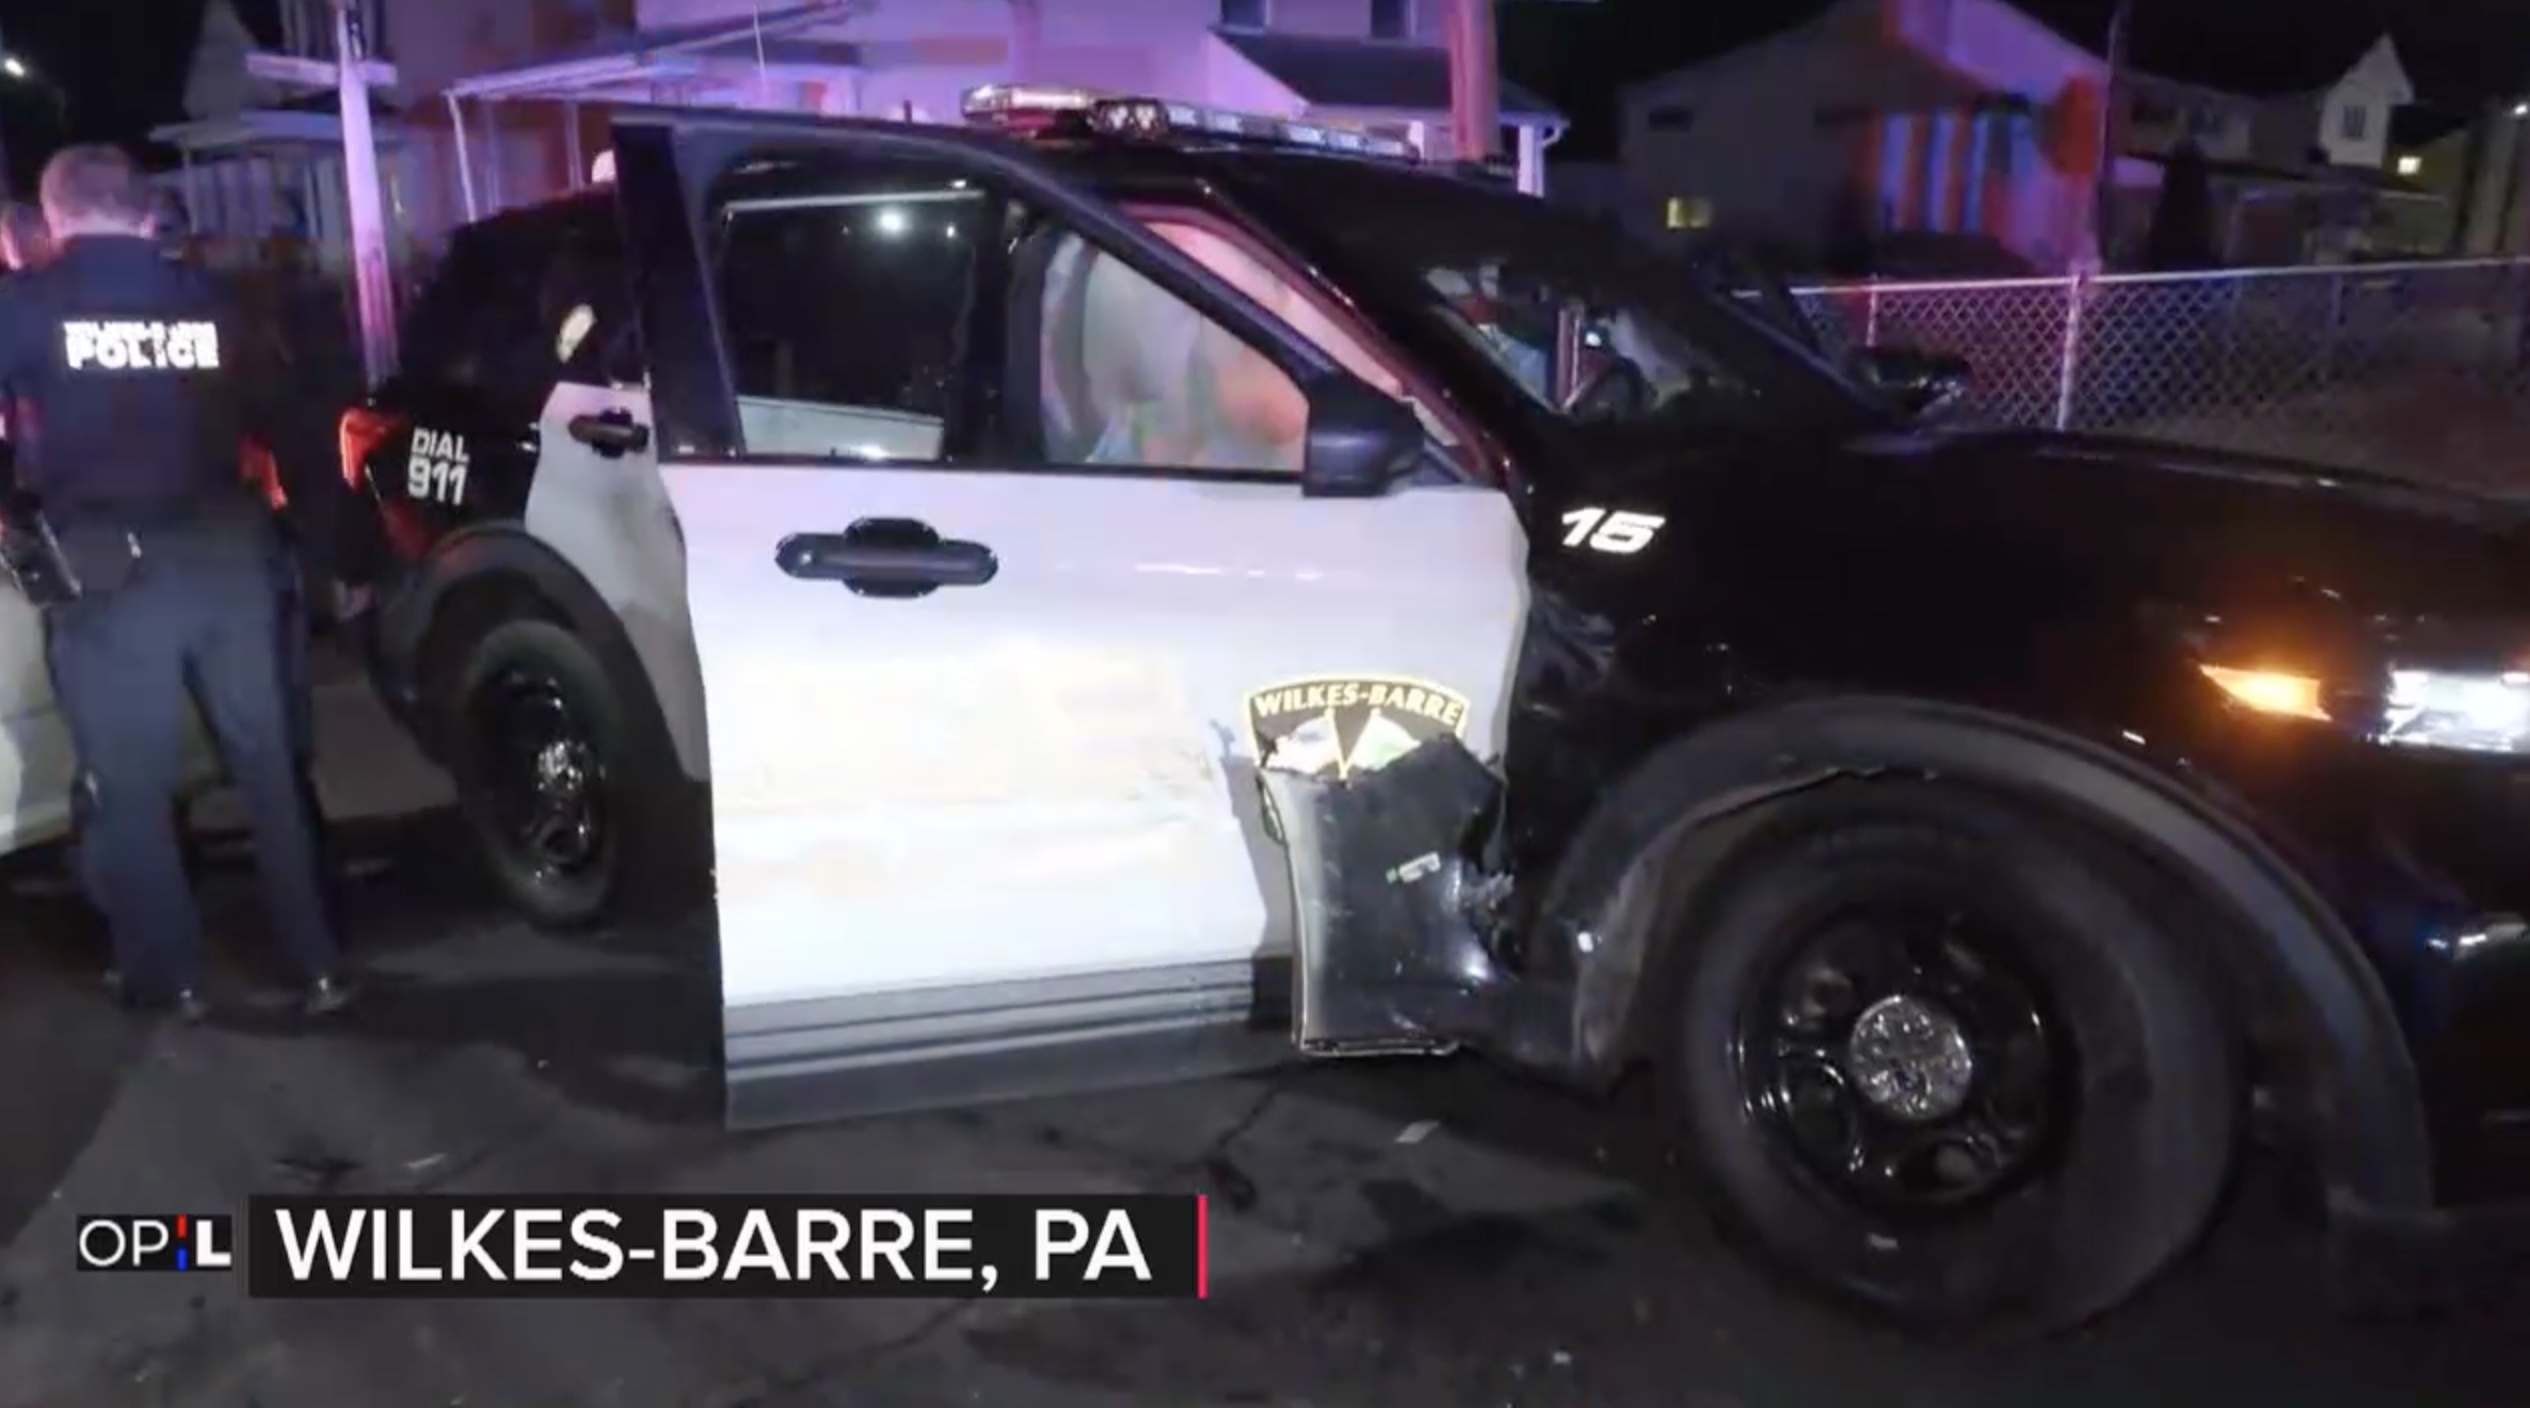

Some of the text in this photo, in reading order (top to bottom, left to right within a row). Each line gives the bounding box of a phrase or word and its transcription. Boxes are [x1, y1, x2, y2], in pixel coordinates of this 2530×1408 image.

[65, 336, 219, 370] POLICE
[410, 427, 470, 463] DIAL
[408, 456, 467, 506] 911
[1561, 507, 1666, 554] 15
[1254, 682, 1463, 725] WILKES-BARRE
